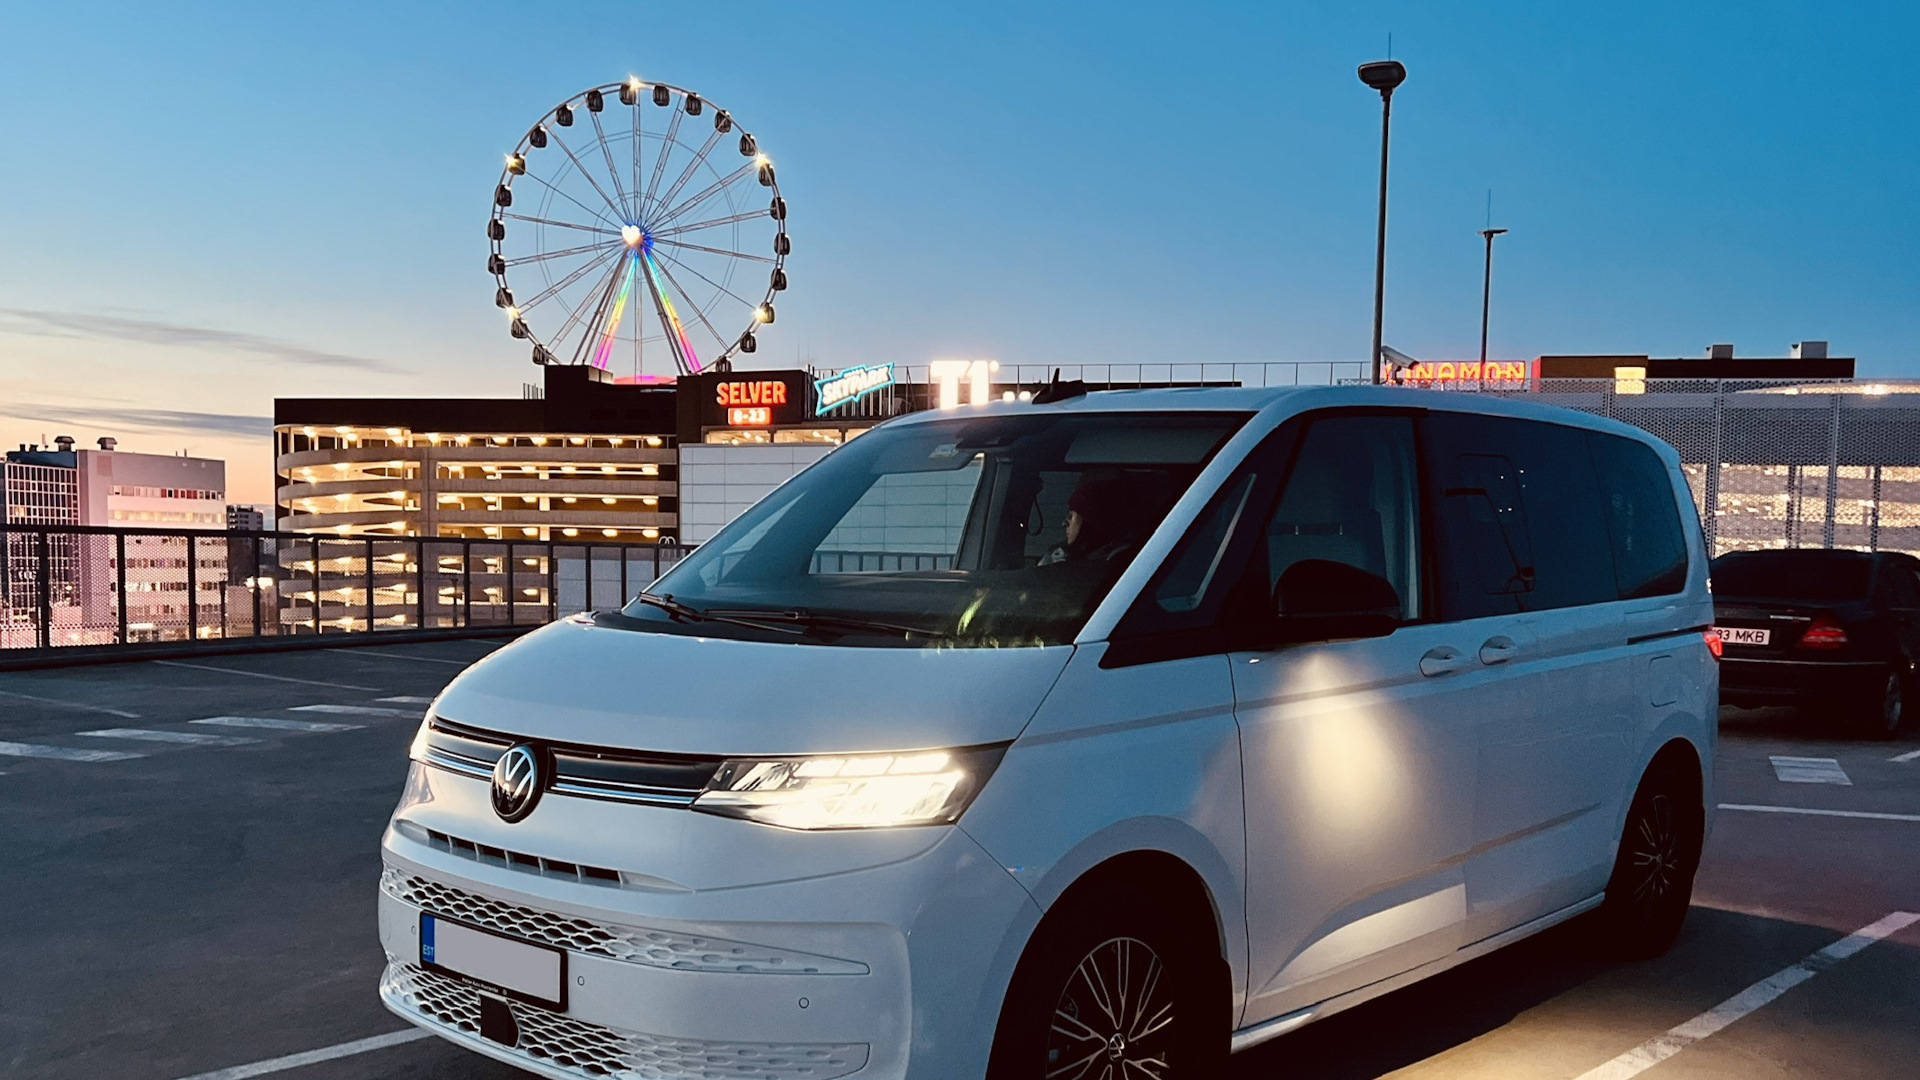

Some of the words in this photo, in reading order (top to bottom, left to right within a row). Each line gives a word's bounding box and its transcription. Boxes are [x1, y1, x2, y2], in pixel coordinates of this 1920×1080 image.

[716, 381, 786, 405] SELVER
[822, 367, 889, 405] SKYPARK
[930, 360, 989, 409] T1
[1735, 630, 1765, 643] MKB
[423, 944, 434, 956] EST
